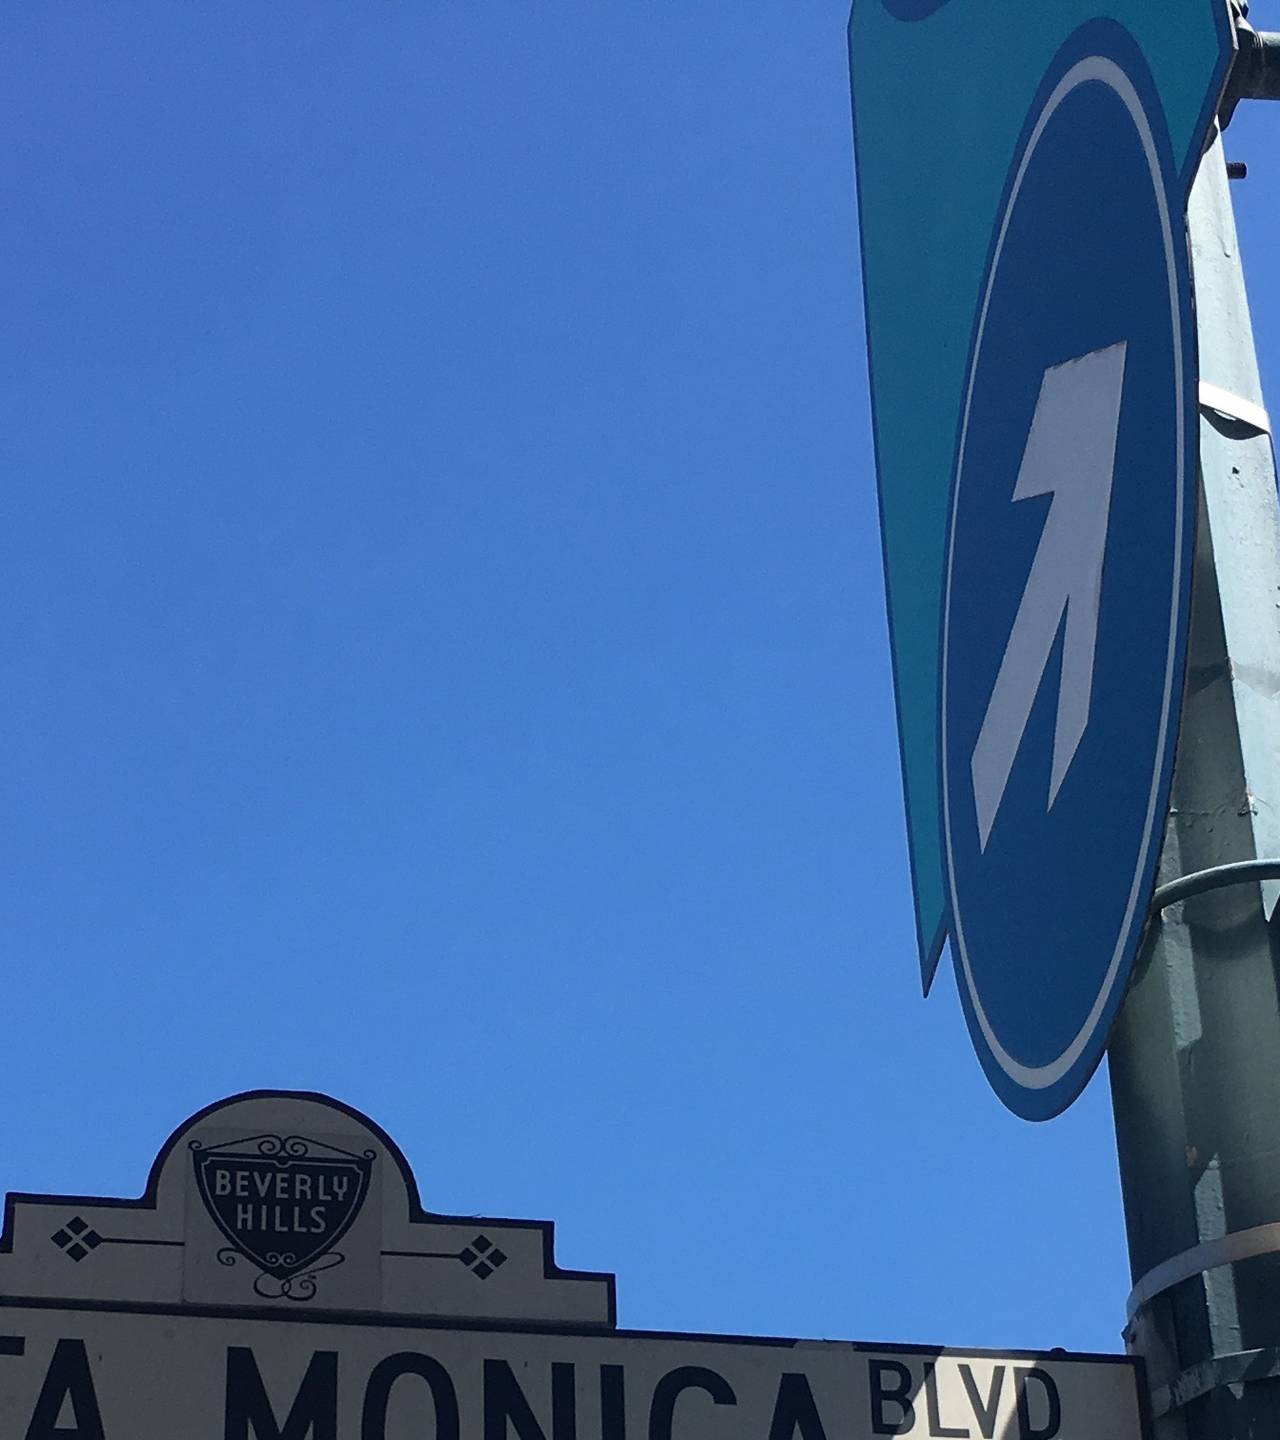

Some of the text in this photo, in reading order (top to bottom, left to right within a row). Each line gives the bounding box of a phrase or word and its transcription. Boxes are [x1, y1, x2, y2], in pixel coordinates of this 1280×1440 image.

[215, 1169, 349, 1201] BEVERLY
[236, 1203, 327, 1234] HILLS
[867, 1358, 1062, 1440] BLVD
